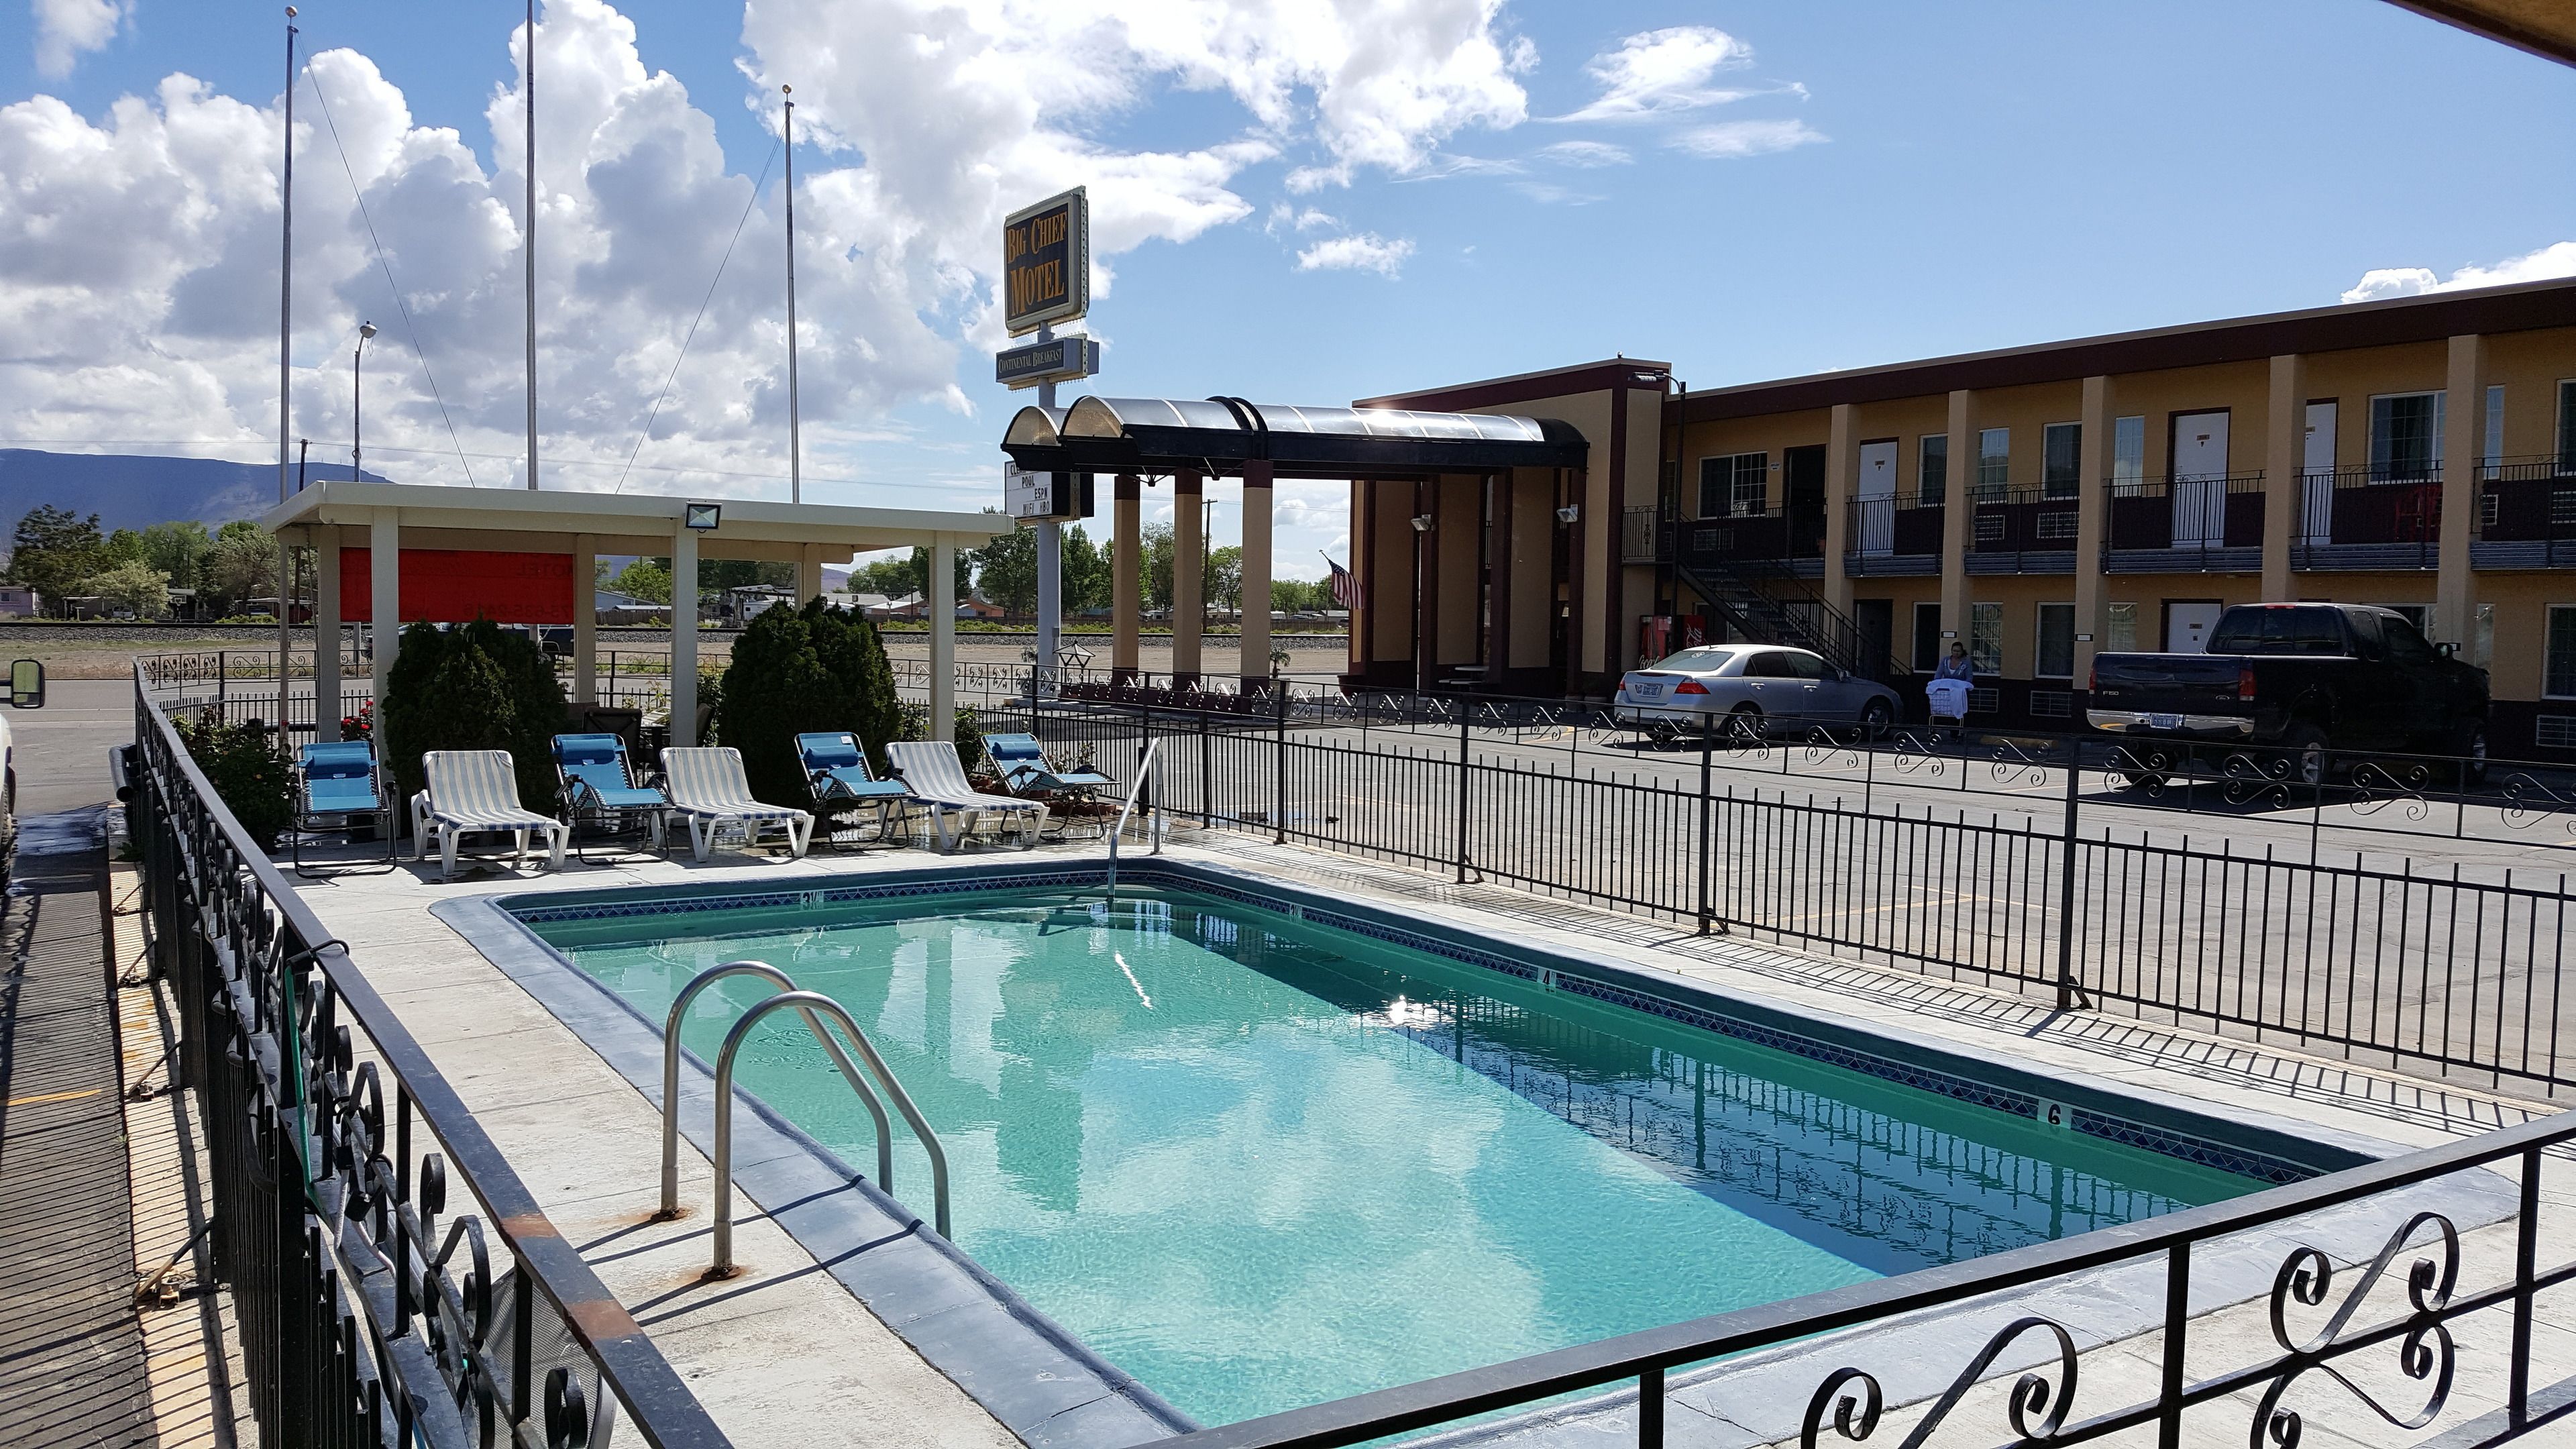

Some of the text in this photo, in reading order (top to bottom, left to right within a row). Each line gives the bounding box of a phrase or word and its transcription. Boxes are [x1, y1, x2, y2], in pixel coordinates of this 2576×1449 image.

[1006, 211, 1067, 264] BIG CHIEF
[1010, 259, 1065, 316] MOTEL
[998, 348, 1063, 373] CONTINENTAL BREAKFAST
[1022, 475, 1035, 488] POOL
[1034, 487, 1048, 499] ESPN
[1022, 500, 1050, 515] WIFI HBO
[2048, 1104, 2061, 1125] 6
